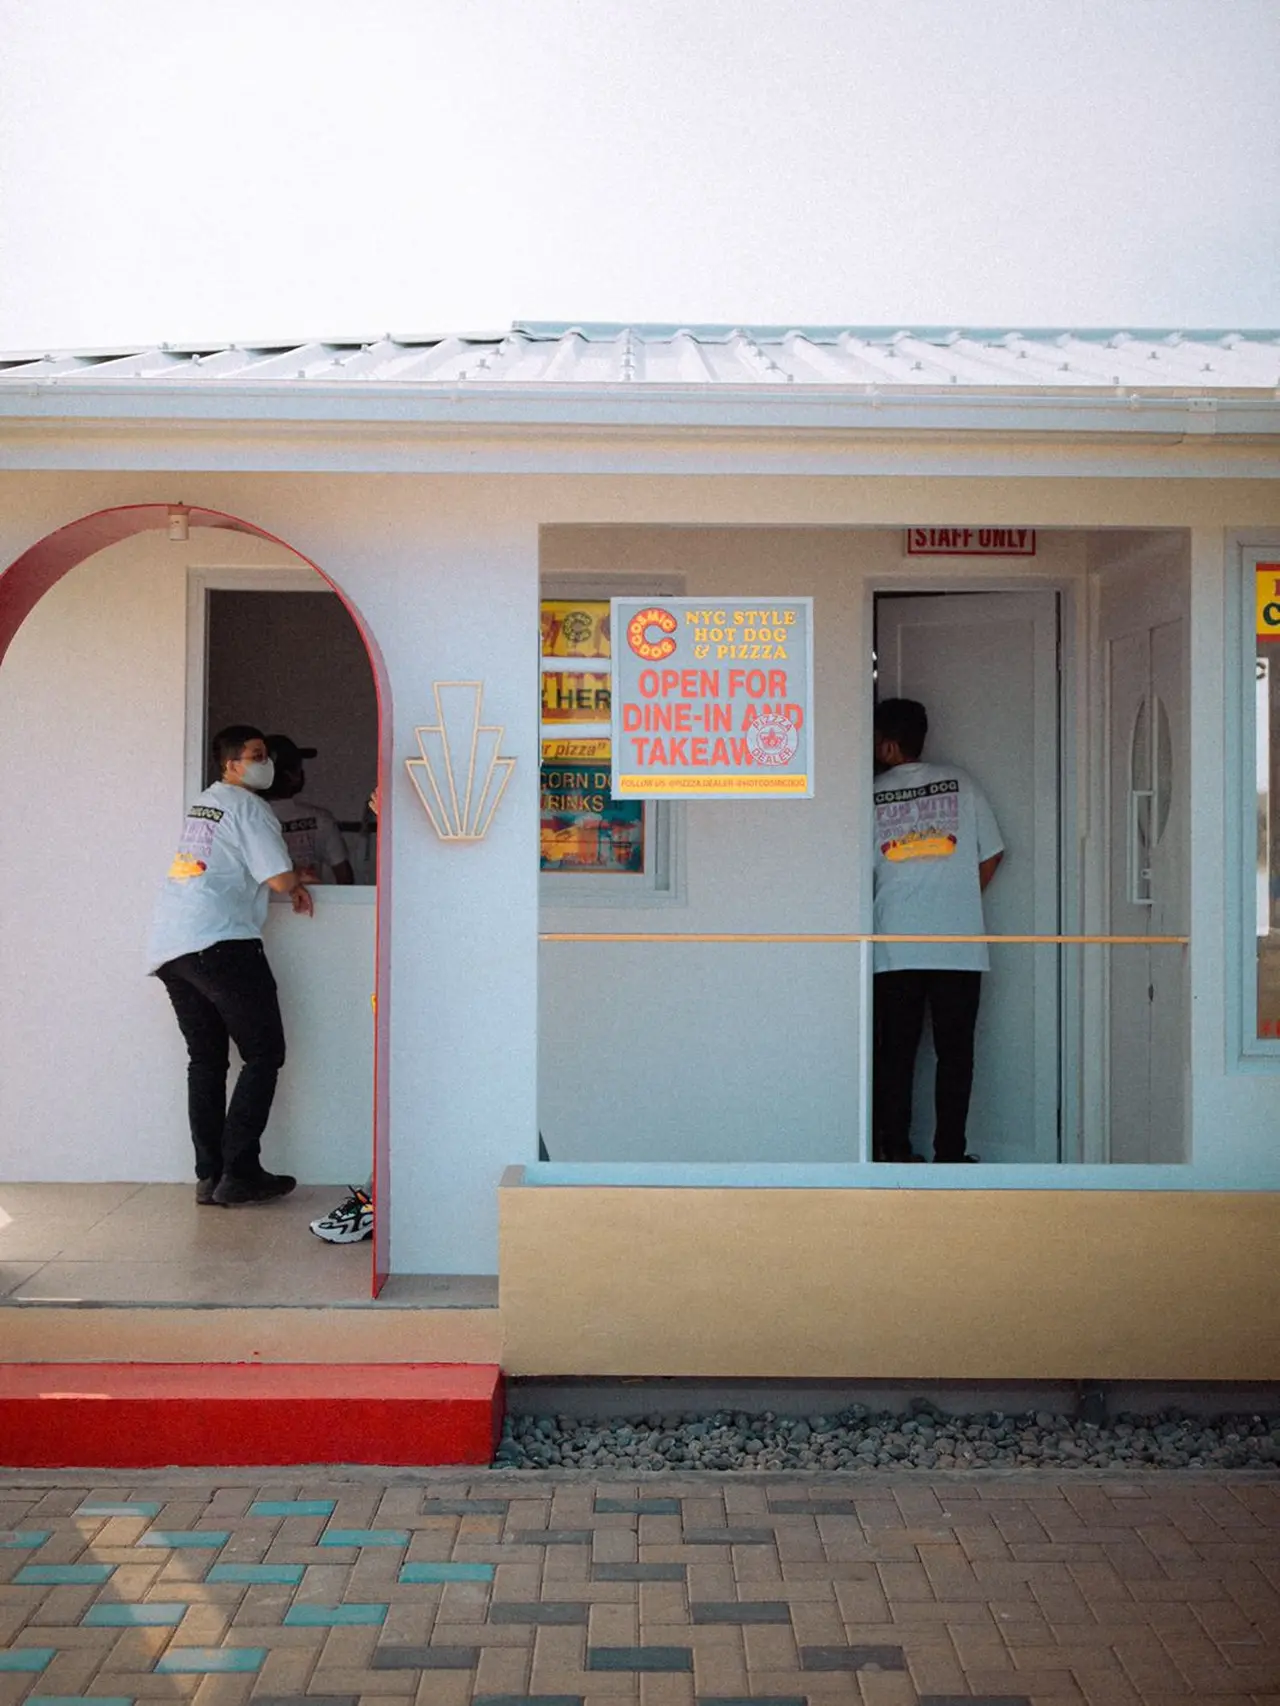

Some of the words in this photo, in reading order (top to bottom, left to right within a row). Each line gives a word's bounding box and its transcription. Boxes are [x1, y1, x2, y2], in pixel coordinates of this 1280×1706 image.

[915, 528, 973, 547] STAFF
[978, 528, 1027, 547] ONLY
[685, 611, 726, 625] NYC
[733, 611, 796, 625] STYLE
[631, 610, 674, 647] COSMIC
[694, 628, 736, 642] HOT
[744, 628, 787, 642] DOG
[639, 640, 673, 658] DOG
[694, 645, 710, 659] &
[717, 645, 788, 659] PIZZZA
[638, 669, 719, 698] OPEN
[728, 669, 787, 698] FOR
[623, 703, 732, 732] DINE-IN
[631, 737, 788, 767] TAKEAW
[751, 747, 793, 764] DEALER
[594, 772, 612, 789] D
[875, 788, 927, 803] COSMIC
[929, 781, 957, 793] DOG
